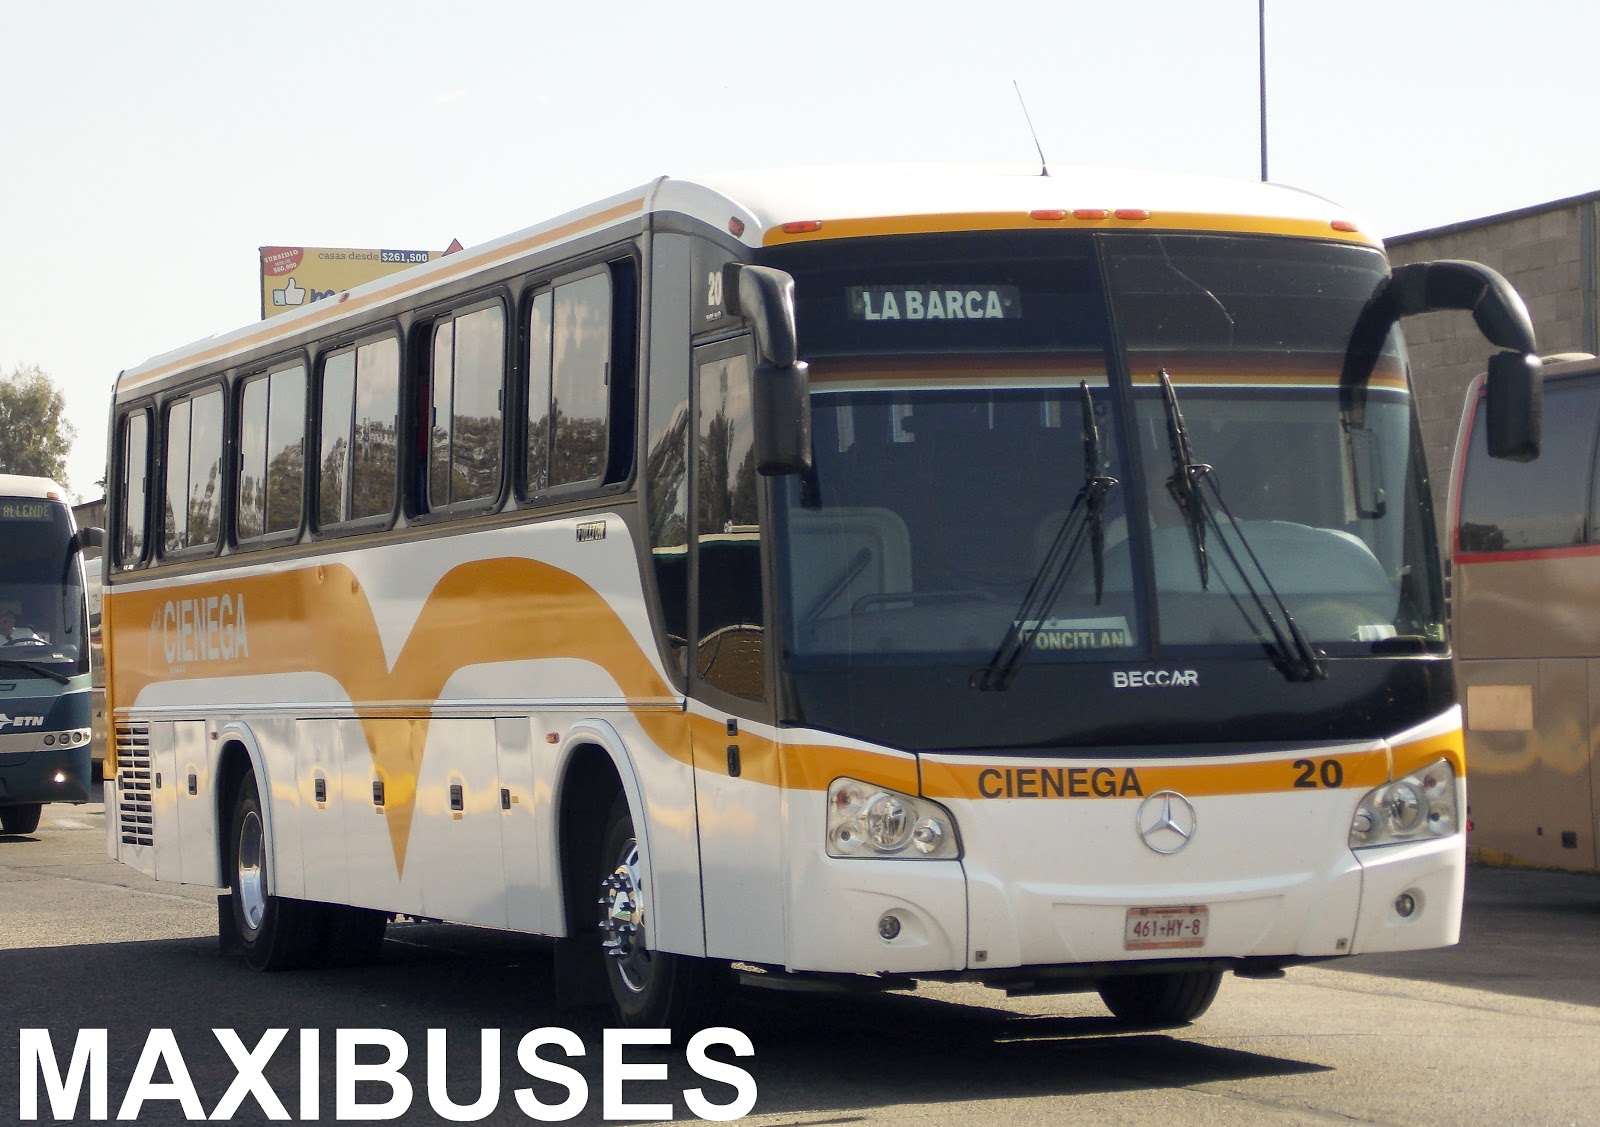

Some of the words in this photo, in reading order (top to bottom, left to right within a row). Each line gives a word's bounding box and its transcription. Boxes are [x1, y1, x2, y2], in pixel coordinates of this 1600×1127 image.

[264, 249, 299, 263] SUBSIDIO
[318, 252, 346, 260] casas
[349, 251, 379, 261] desde
[382, 252, 428, 263] $261,500
[708, 271, 722, 306] 20
[863, 291, 900, 320] LA
[905, 290, 1004, 320] BARCA
[2, 504, 50, 518] ALLENDE
[163, 593, 249, 664] CIENEGA
[1112, 670, 1200, 688] BECCAR
[12, 715, 44, 727] ETN
[978, 768, 1143, 799] CIENEGA
[1293, 759, 1344, 789] 20
